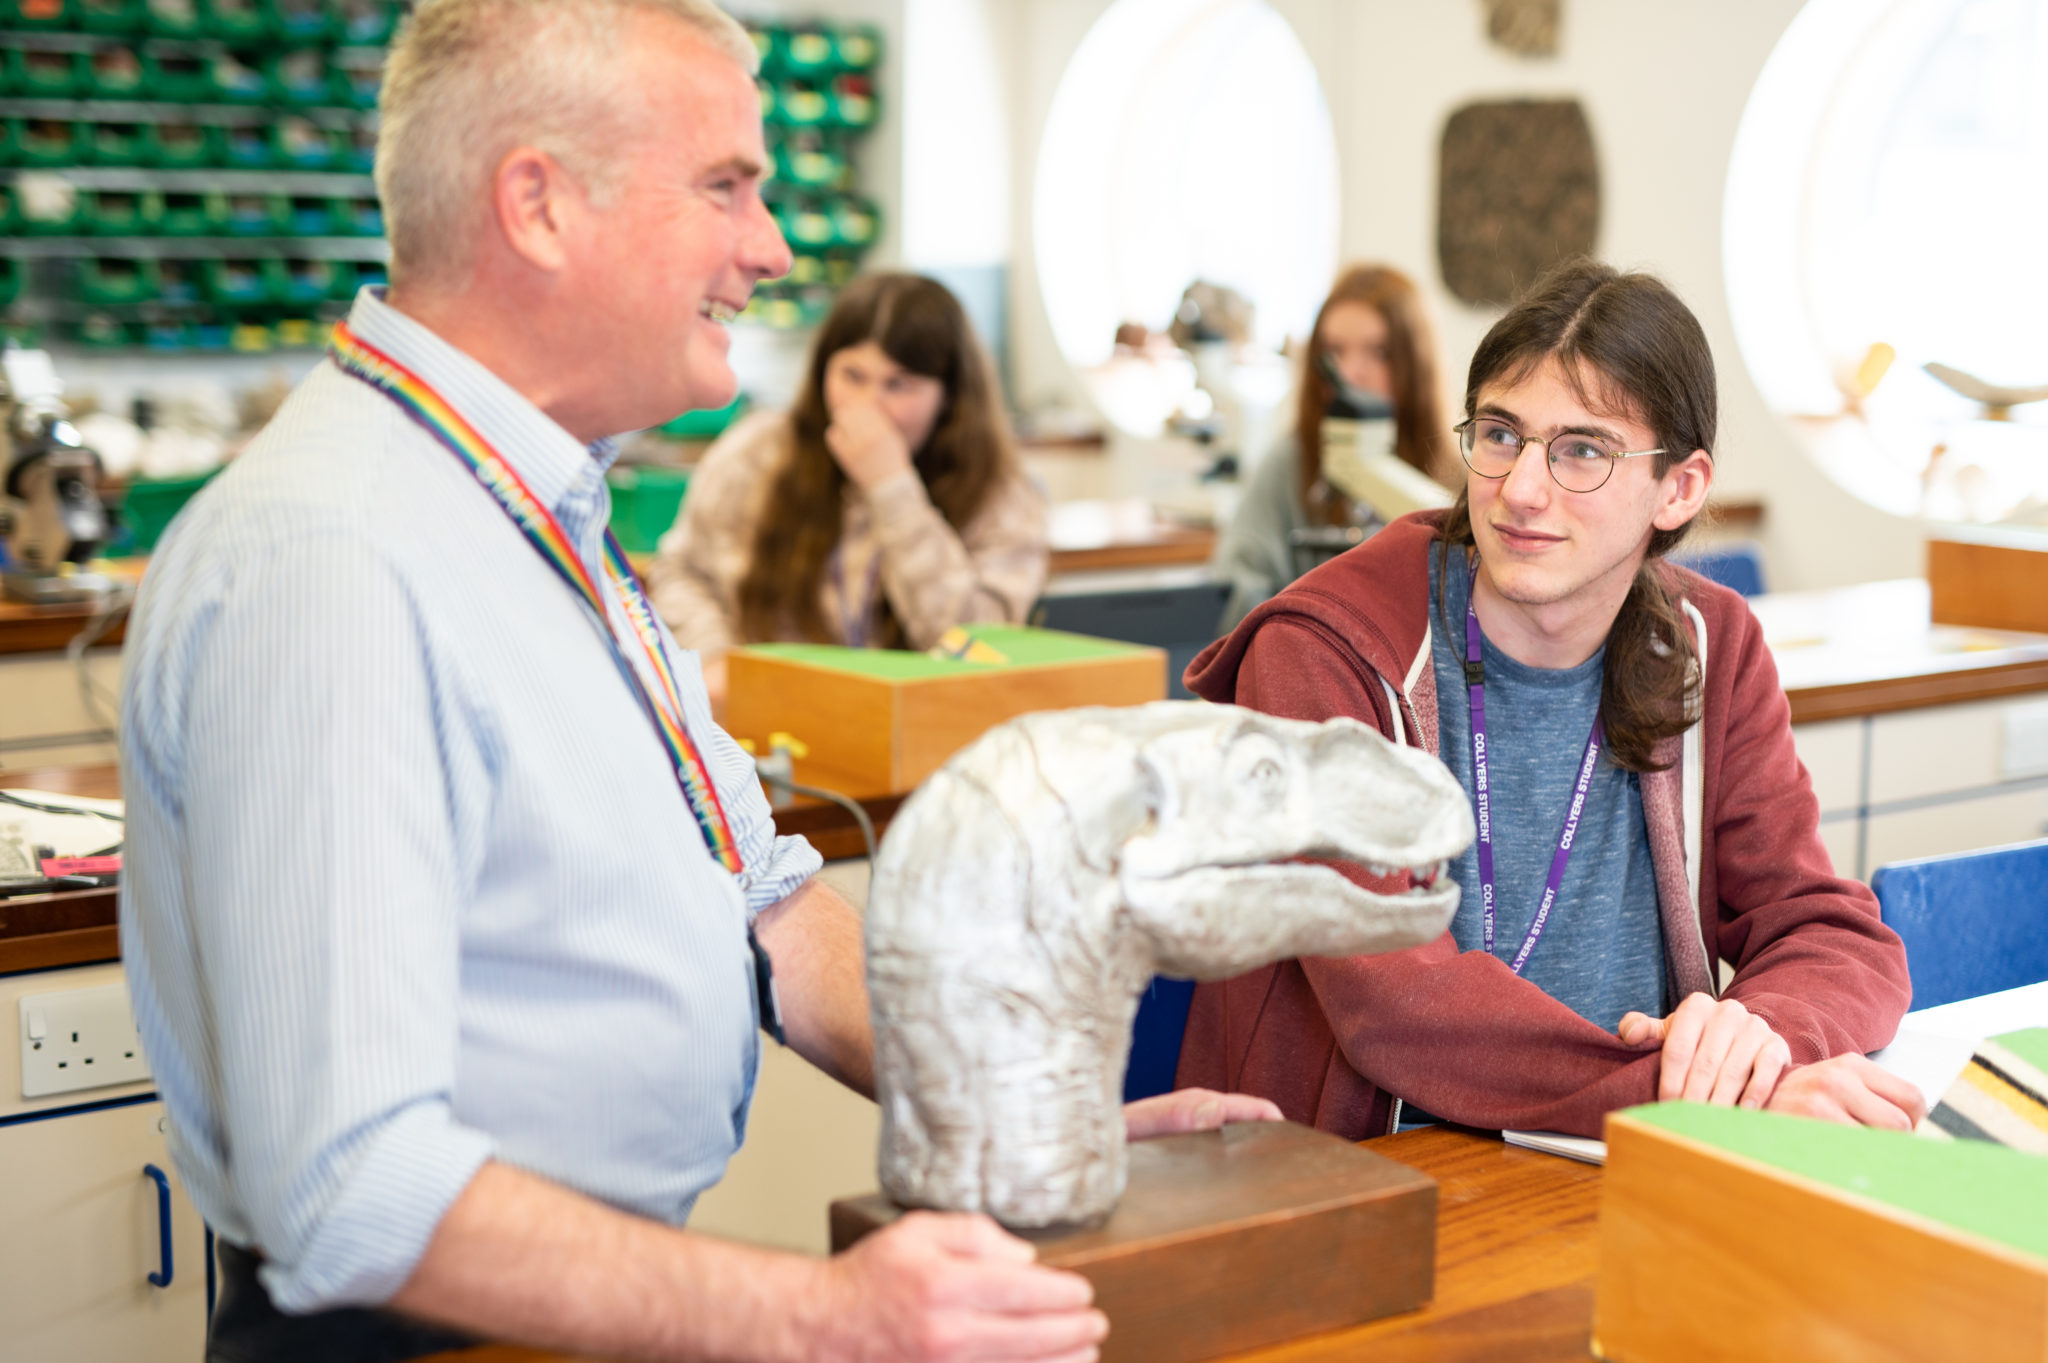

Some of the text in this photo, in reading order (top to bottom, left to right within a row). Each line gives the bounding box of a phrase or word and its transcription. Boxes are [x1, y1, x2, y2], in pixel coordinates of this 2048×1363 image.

[476, 457, 548, 531] STAFF
[615, 577, 661, 646] STAFF
[678, 760, 724, 827] STAFF
[1475, 733, 1490, 843] COLLYERS STUDENT
[1560, 742, 1599, 850] COLLYERS STUDENT
[1483, 884, 1494, 941] COLLYERS
[1512, 887, 1555, 974] LLYERS STUDENT
